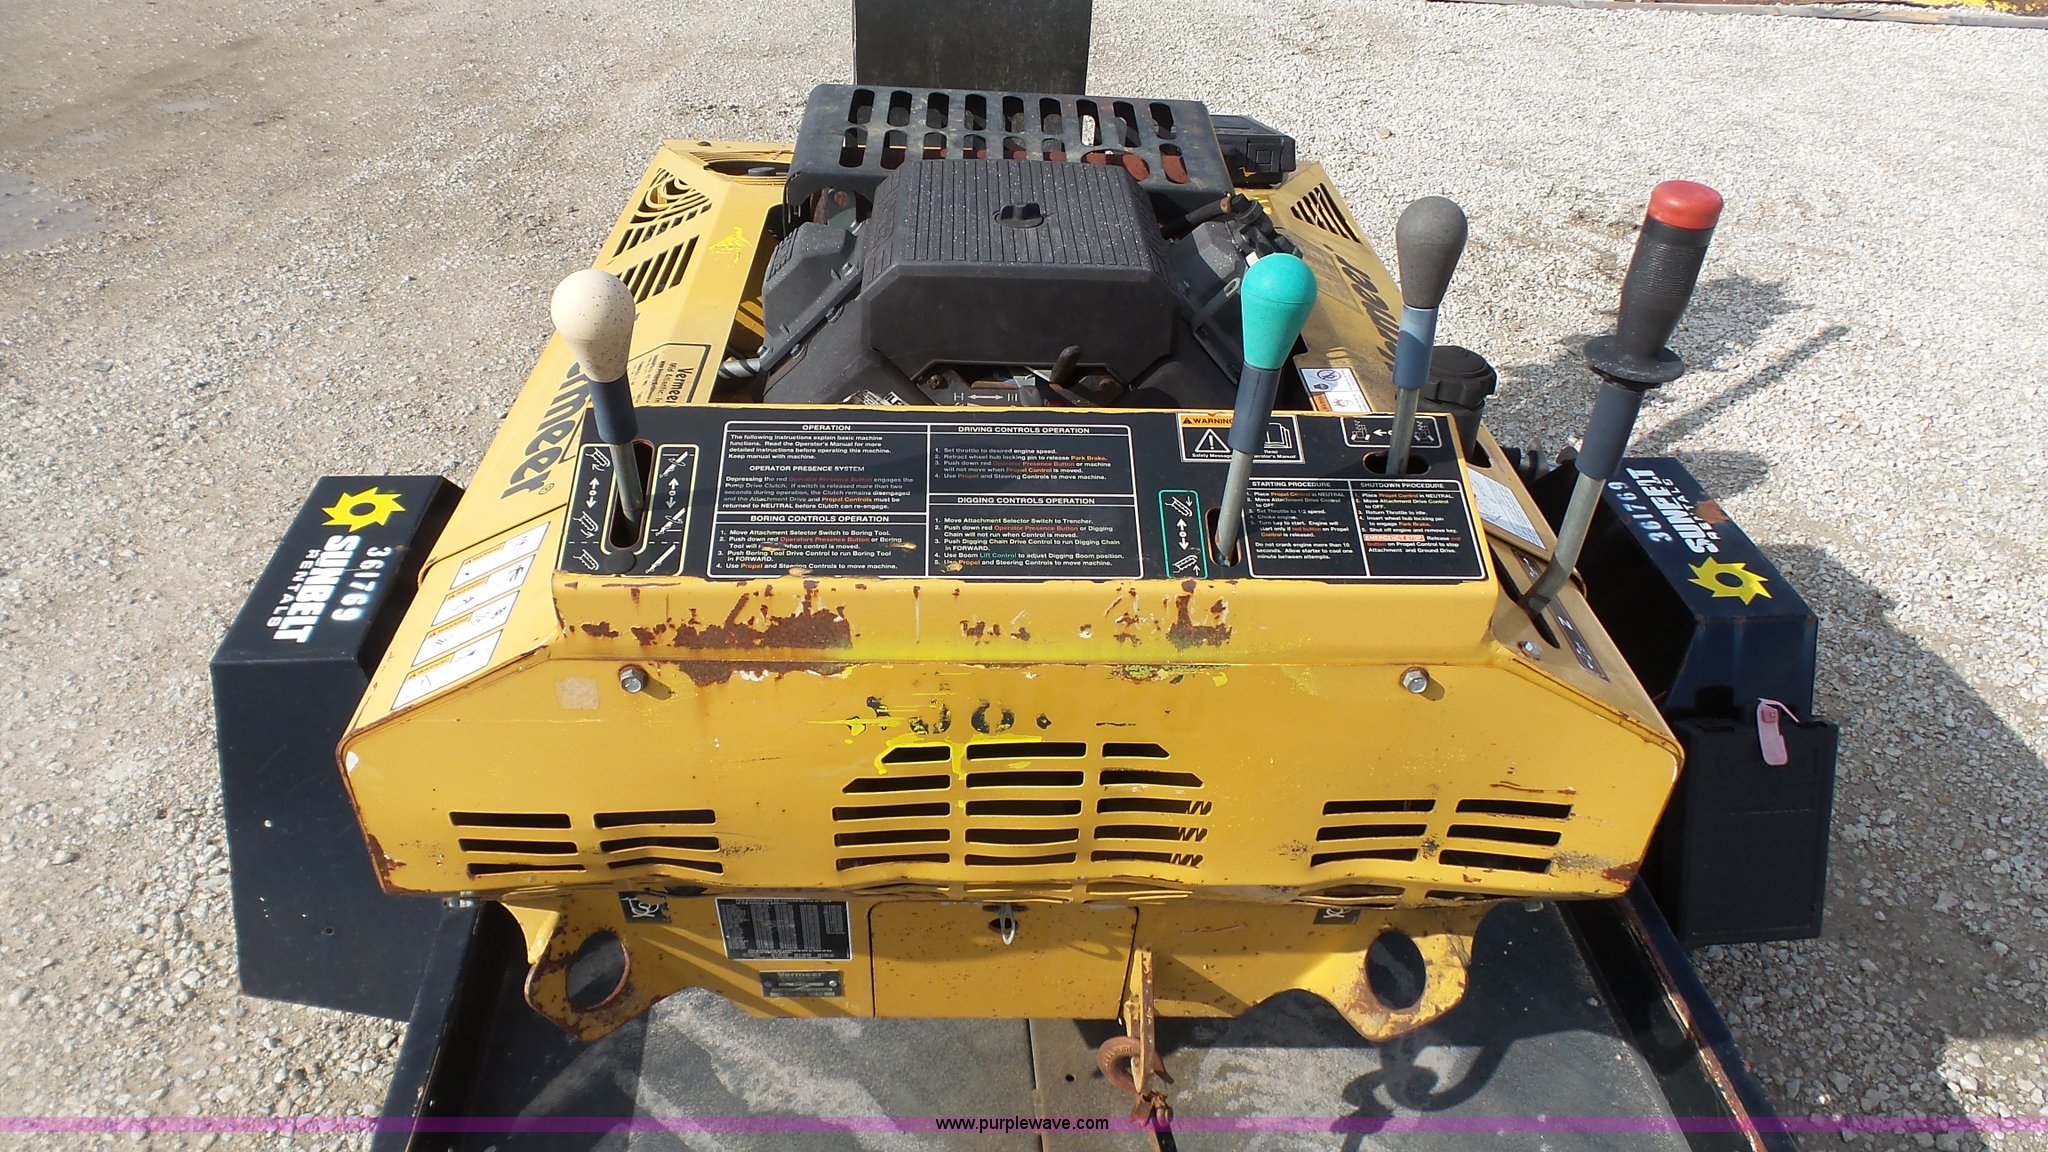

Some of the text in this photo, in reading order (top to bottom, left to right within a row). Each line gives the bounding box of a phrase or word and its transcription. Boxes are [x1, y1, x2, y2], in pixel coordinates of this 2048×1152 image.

[501, 362, 591, 500] rmeer
[1608, 482, 1674, 542] 361769
[1626, 468, 1719, 554] SUNBELT
[266, 550, 320, 628] RENTALS
[273, 535, 361, 643] SUNBELT
[331, 546, 392, 621] 361769
